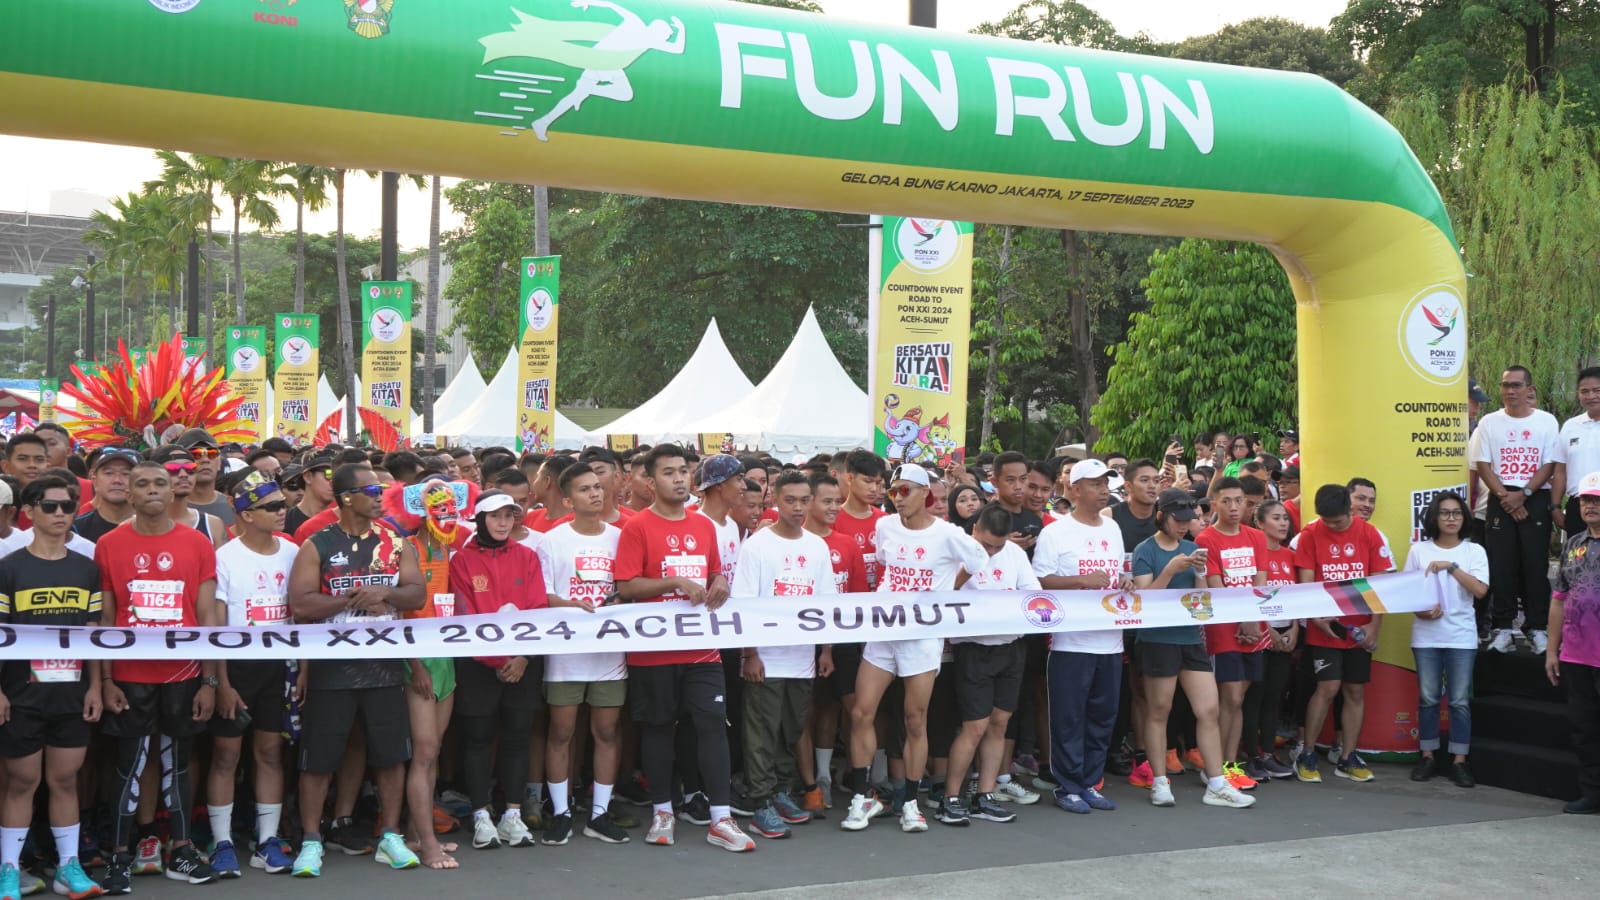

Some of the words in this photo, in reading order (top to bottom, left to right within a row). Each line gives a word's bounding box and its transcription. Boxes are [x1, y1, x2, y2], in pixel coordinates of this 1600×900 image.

[253, 11, 299, 27] KONI
[713, 22, 959, 131] FUN
[985, 56, 1214, 154] RUN
[841, 172, 900, 187] GELORA
[903, 177, 945, 190] BUNG
[946, 180, 998, 194] KARNO
[998, 185, 1063, 201] JAKARTA,
[1067, 190, 1083, 201] 17
[1082, 191, 1159, 207] SEPTEMBER
[1160, 197, 1195, 209] 2023
[888, 283, 939, 293] COUNTDOWN
[940, 286, 964, 295] EVENT
[908, 295, 931, 303] ROAD
[932, 296, 943, 304] TO
[897, 304, 915, 313] PON
[915, 305, 930, 314] XXI
[932, 306, 952, 315] 2024
[900, 315, 950, 324] ACEH-SUMUT
[896, 343, 950, 357] BERSATU
[371, 381, 401, 389] BERSATU
[526, 379, 549, 389] BERSATU
[1395, 402, 1457, 413] COUNTDOWN
[1426, 417, 1451, 428] ROAD
[1453, 417, 1461, 428] TO
[1412, 432, 1434, 443] PON
[1436, 432, 1452, 443] XXI
[1416, 447, 1465, 458] ACEH-SUMUT
[1500, 447, 1525, 455] ROAD
[1526, 447, 1539, 455] TO
[1500, 455, 1520, 463] PON
[1523, 455, 1539, 463] XXI
[1500, 462, 1537, 475] 2024
[582, 557, 611, 570] 2662
[1079, 559, 1106, 568] ROAD
[1108, 559, 1119, 568] TO
[1229, 556, 1252, 568] 2236
[1322, 562, 1349, 572] ROAD
[1350, 561, 1364, 571] TO
[674, 566, 702, 577] 1880
[889, 565, 916, 577] ROAD
[919, 568, 934, 577] TO
[1323, 571, 1345, 580] PON
[1346, 570, 1364, 579] XXI
[889, 574, 910, 586] PON
[913, 577, 933, 587] XXI
[569, 585, 594, 597] PON
[31, 590, 80, 605] GNR
[142, 593, 175, 607] 1164
[263, 605, 287, 620] 1112
[45, 627, 136, 649] TO
[165, 629, 300, 649] PON
[326, 626, 415, 646] XXI
[440, 621, 576, 643] 2024
[596, 611, 743, 640] ACEH
[798, 603, 971, 632] SUMUT
